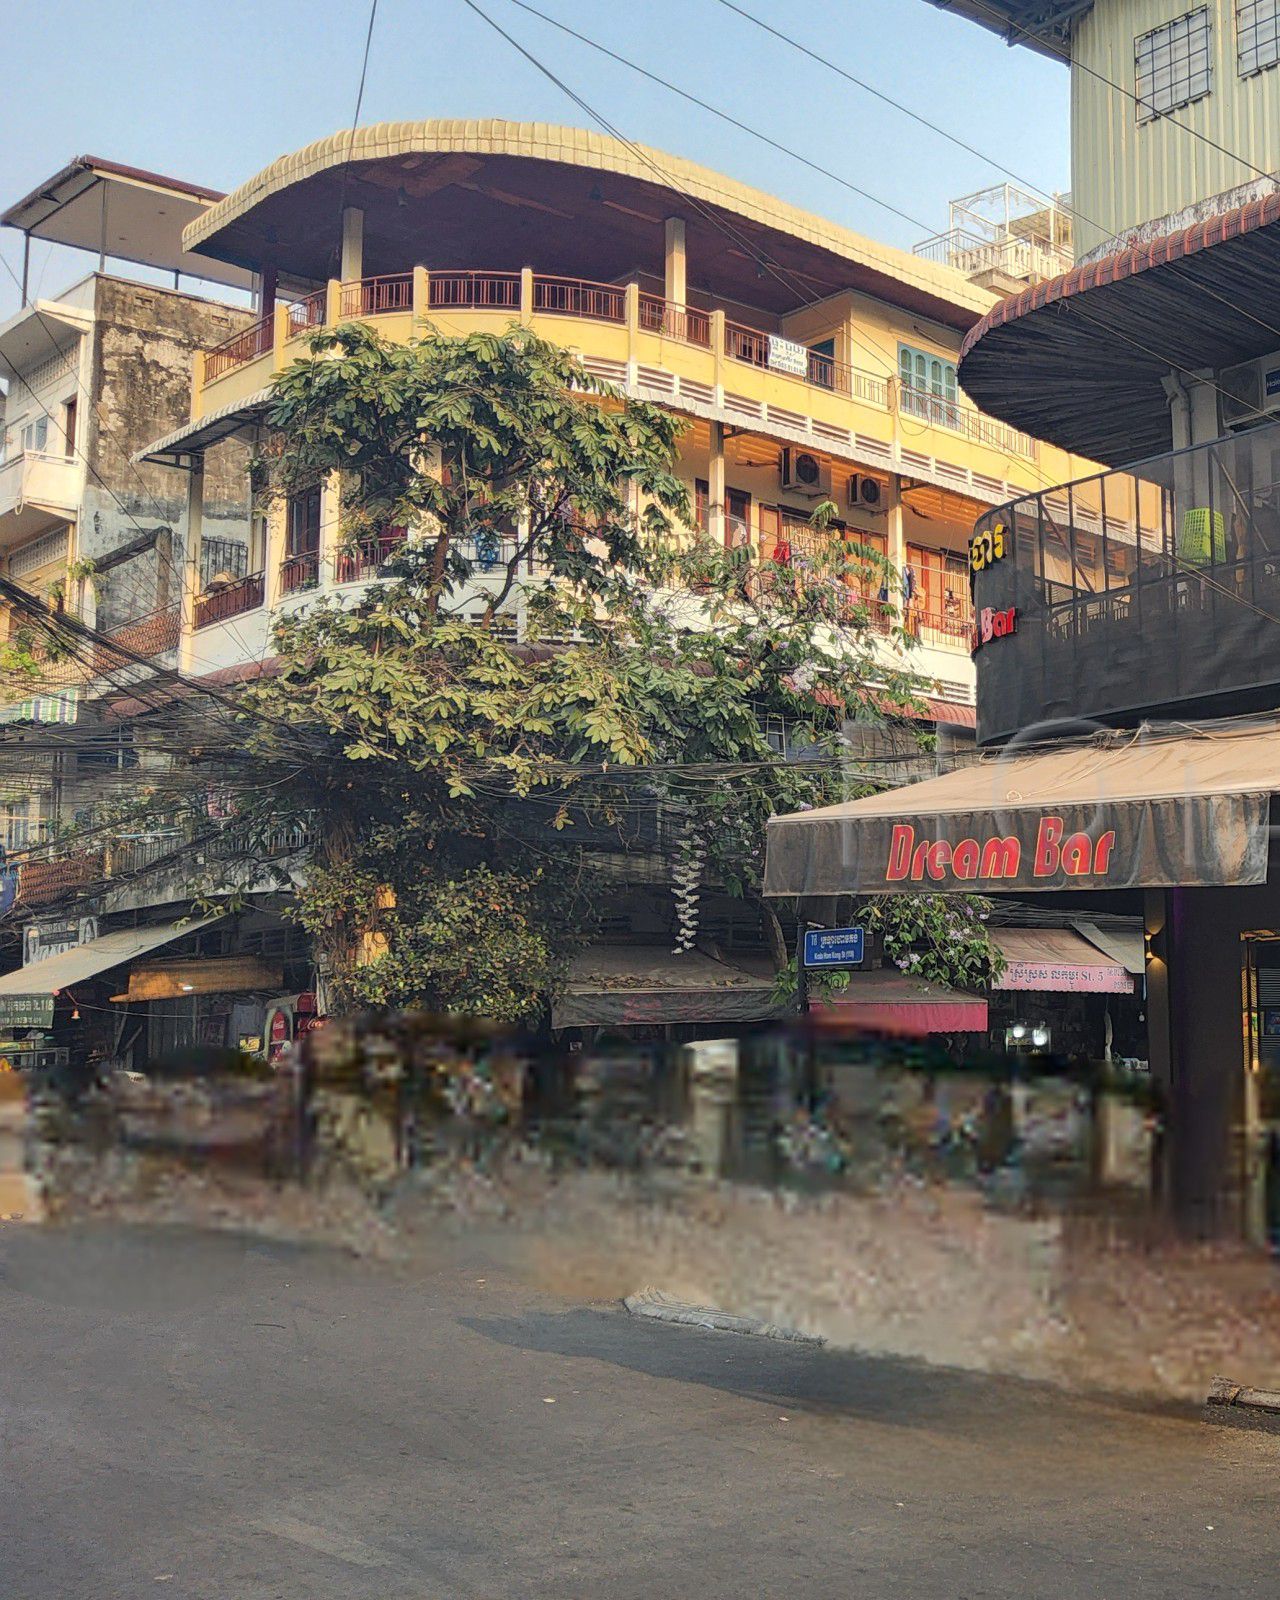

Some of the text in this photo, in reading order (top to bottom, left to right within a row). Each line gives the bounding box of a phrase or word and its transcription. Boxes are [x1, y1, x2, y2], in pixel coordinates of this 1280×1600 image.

[981, 606, 1016, 644] Bar
[886, 816, 1116, 881] Dream Bar
